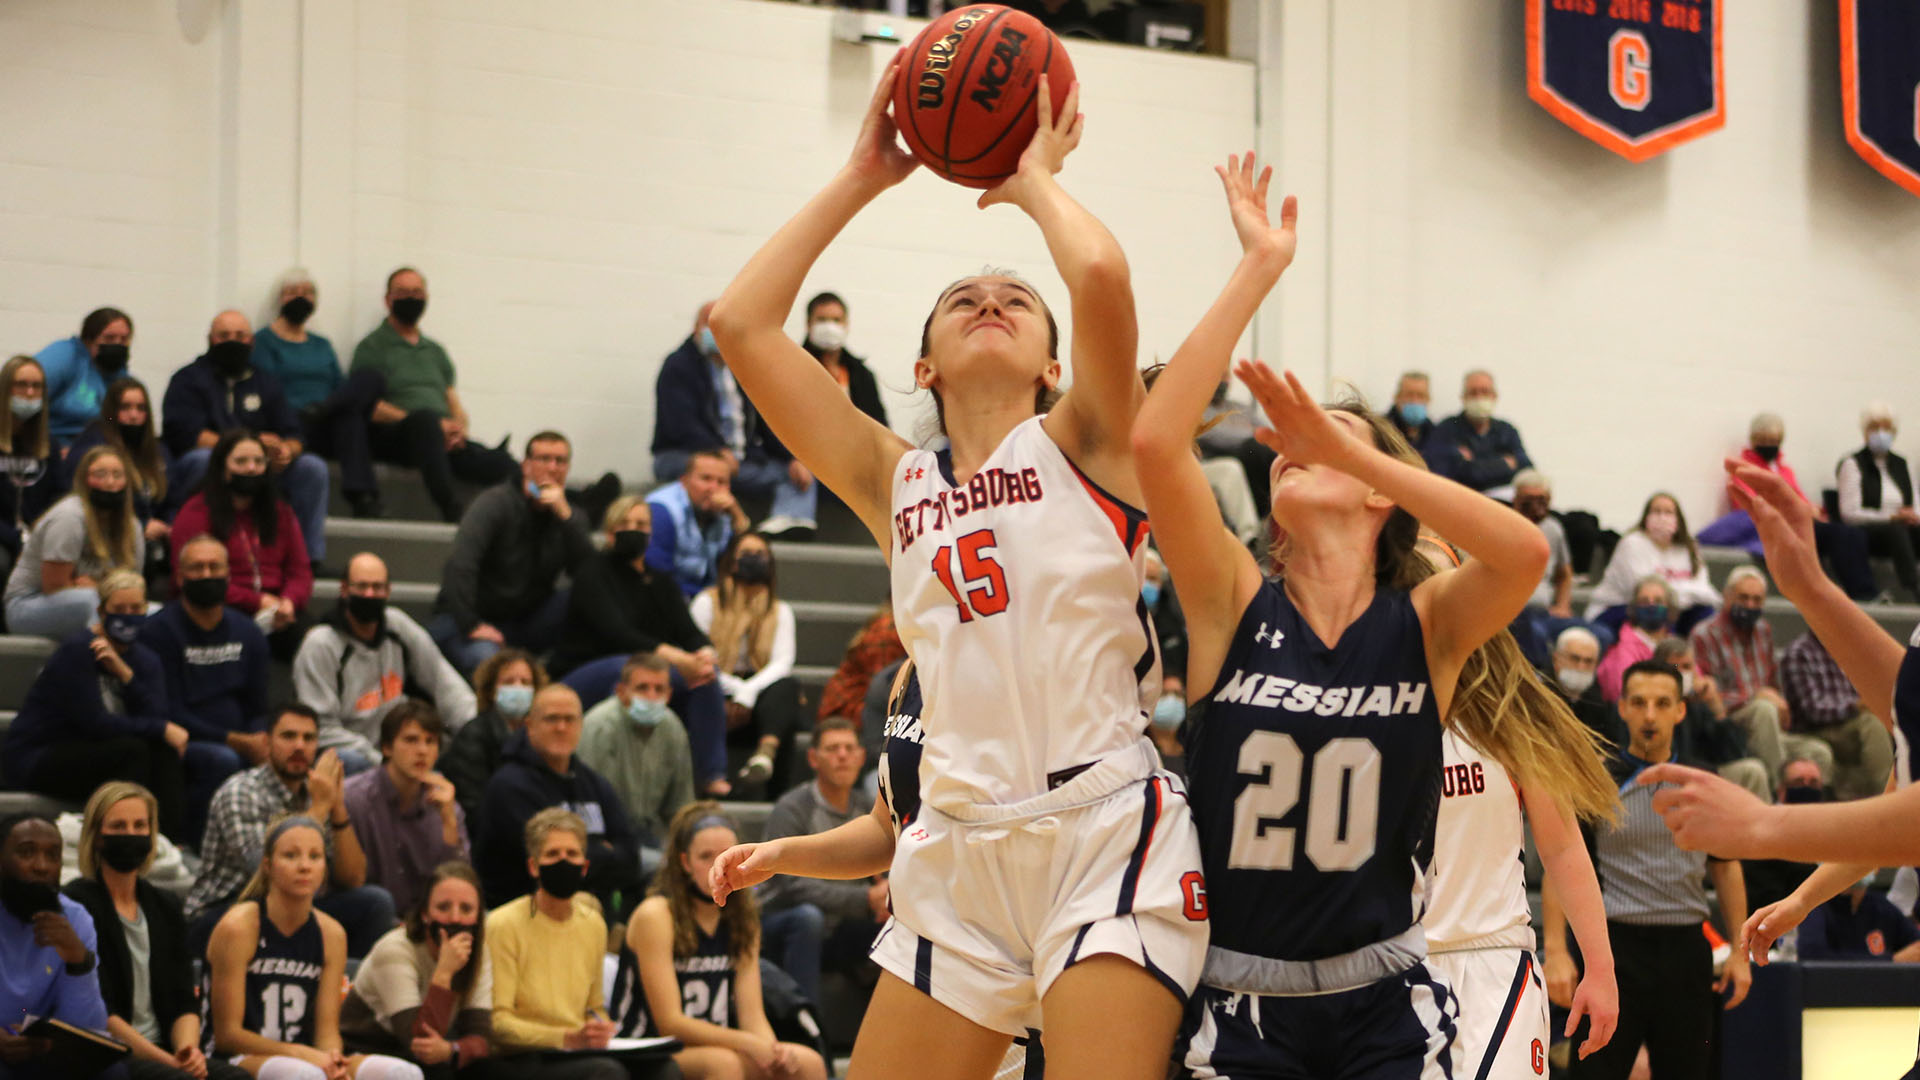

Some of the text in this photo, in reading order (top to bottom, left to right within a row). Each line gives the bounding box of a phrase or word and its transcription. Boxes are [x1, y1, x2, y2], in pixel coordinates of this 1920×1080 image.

[917, 7, 995, 112] Wilson
[970, 27, 1028, 113] NCAA
[1608, 28, 1652, 111] G
[931, 528, 1010, 624] 15
[1213, 668, 1428, 718] MESSIAH
[1227, 729, 1382, 872] 20
[1179, 870, 1209, 921] G
[261, 982, 308, 1043] 12
[682, 978, 730, 1029] 24
[1530, 1037, 1544, 1076] G
